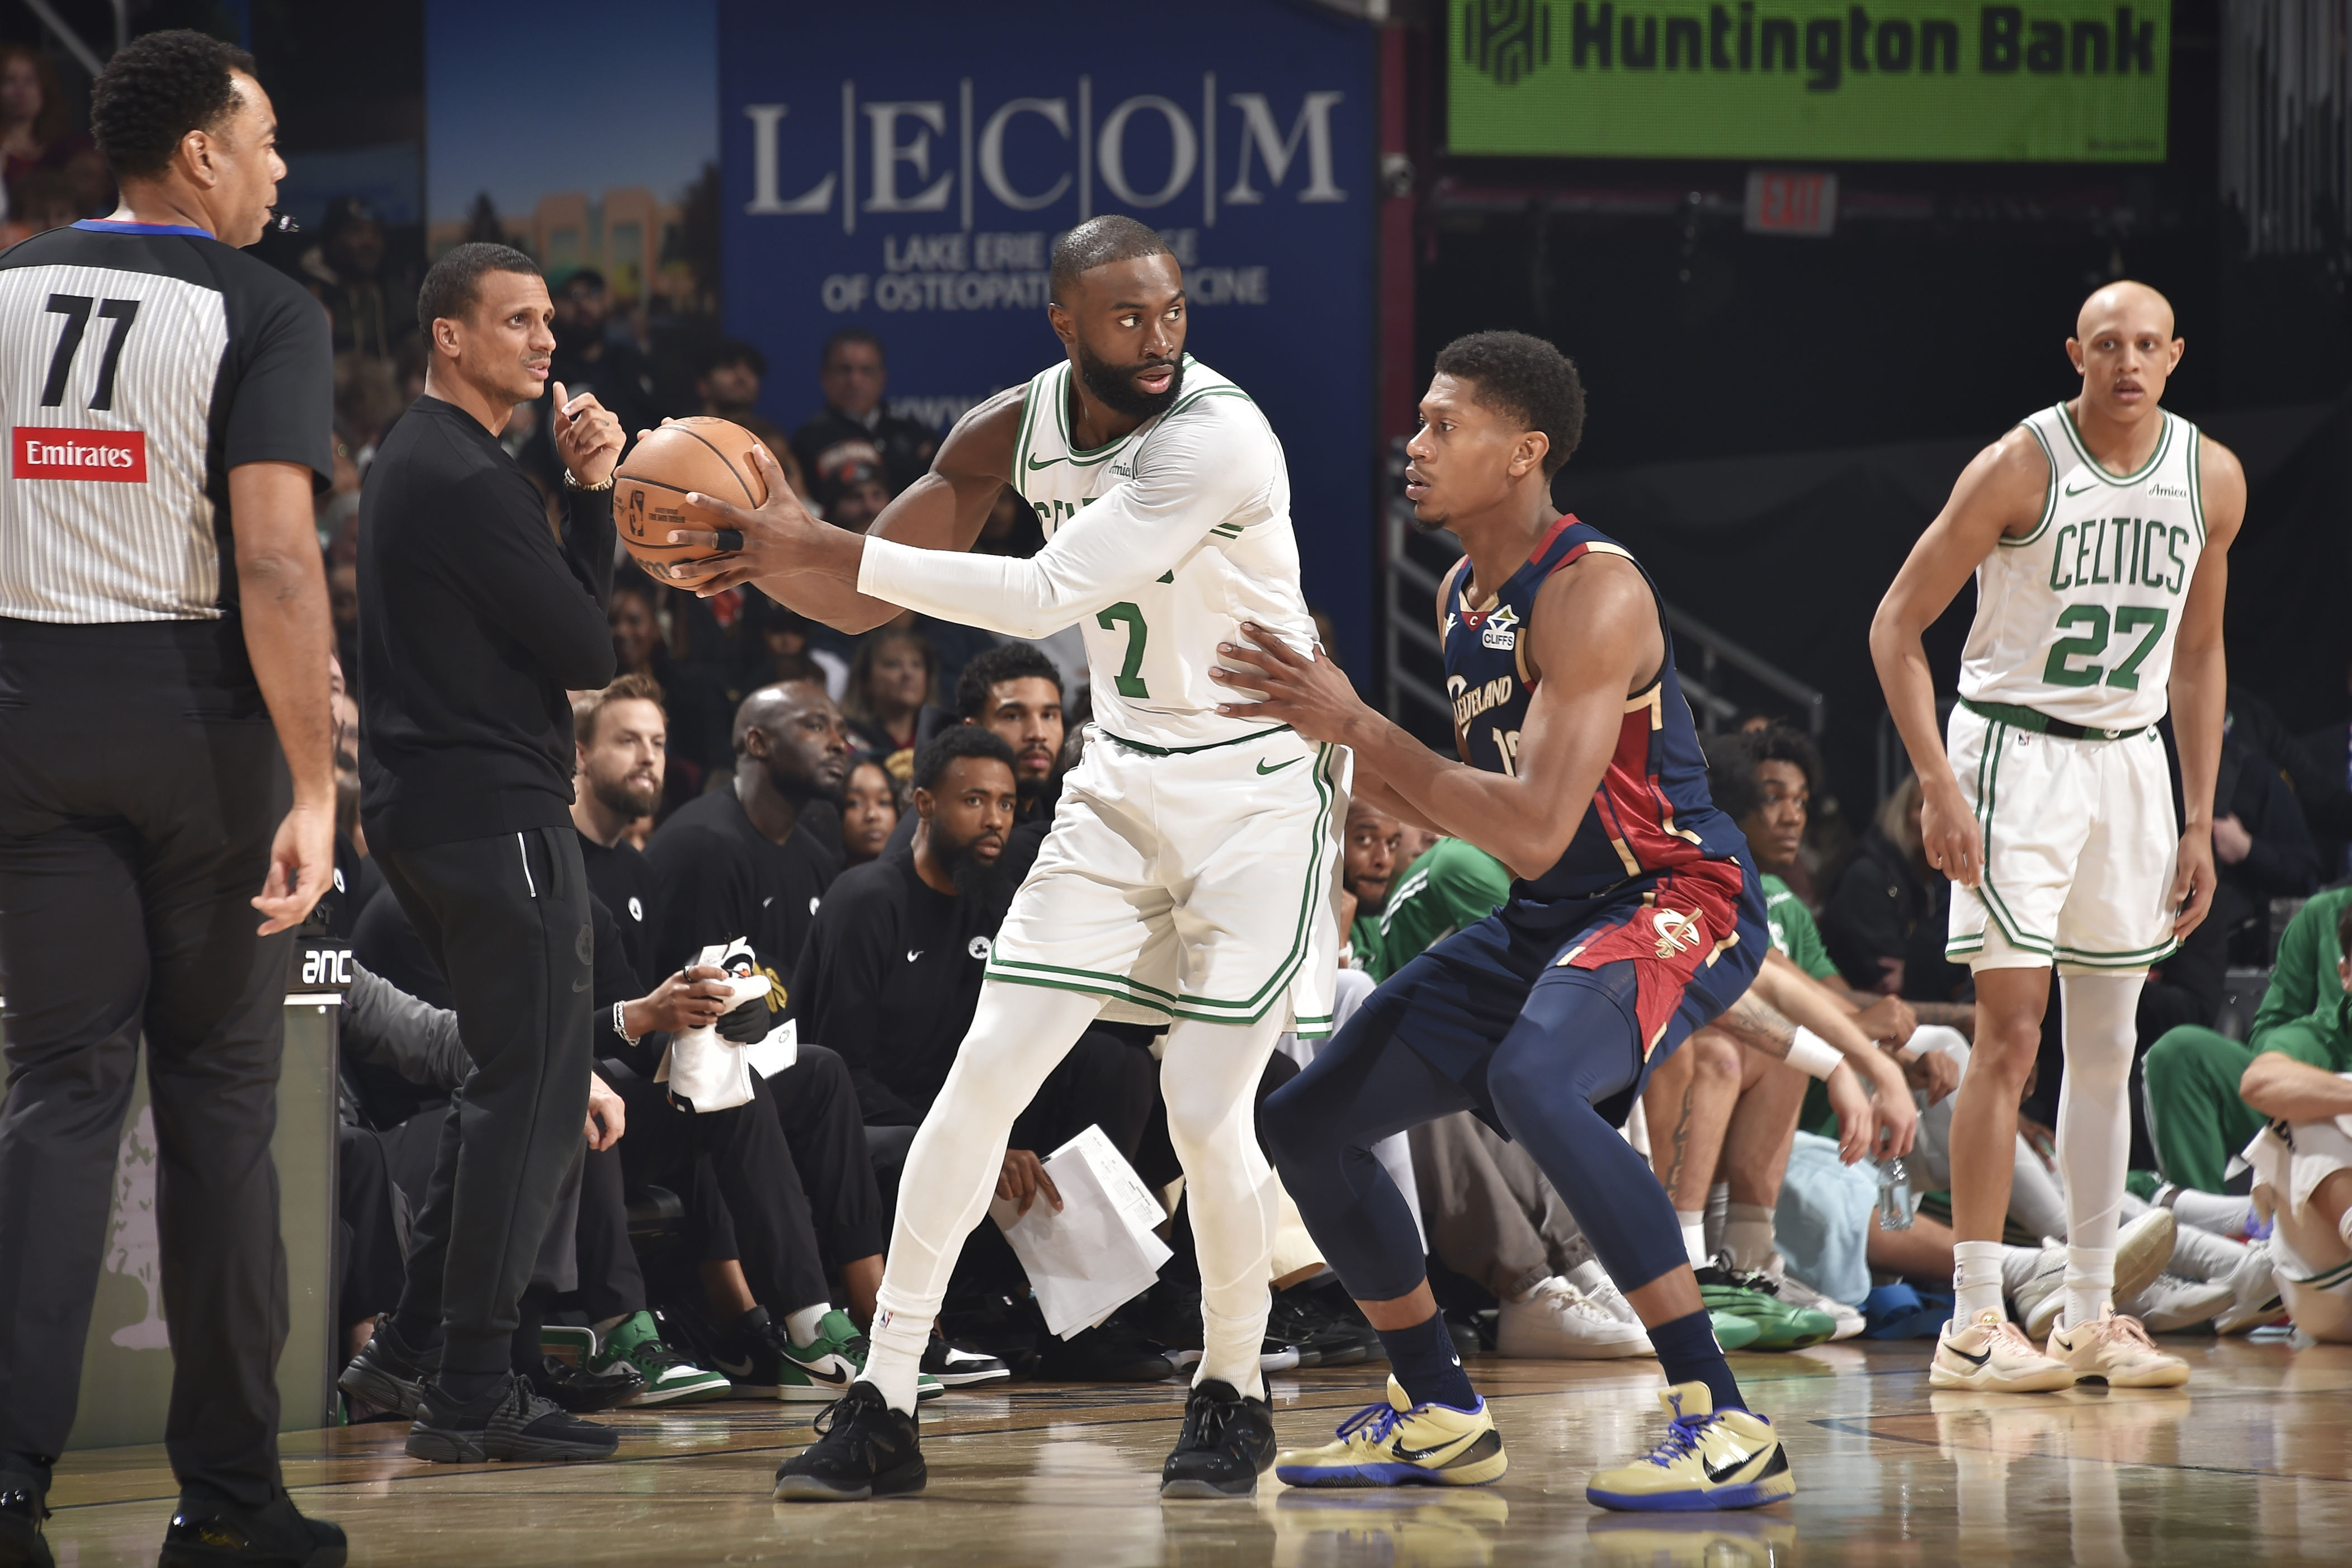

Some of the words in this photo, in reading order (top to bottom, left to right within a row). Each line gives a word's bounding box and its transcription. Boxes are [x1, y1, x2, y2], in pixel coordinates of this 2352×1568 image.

[1573, 1, 1957, 91] Huntington
[1981, 6, 2154, 74] Bank
[1760, 173, 1825, 228] EXIT
[884, 233, 969, 272] LAKE
[974, 230, 1046, 270] ERIE
[821, 273, 868, 313] OF
[41, 293, 141, 411] 77
[26, 440, 133, 468] Emirates
[2148, 483, 2186, 497] Amica
[2049, 518, 2189, 596] CELTICS
[1470, 616, 1479, 626] C
[1484, 633, 1513, 646] CLIFFS
[1096, 601, 1150, 699] 7
[2043, 604, 2169, 691] 27
[303, 950, 352, 984] anc
